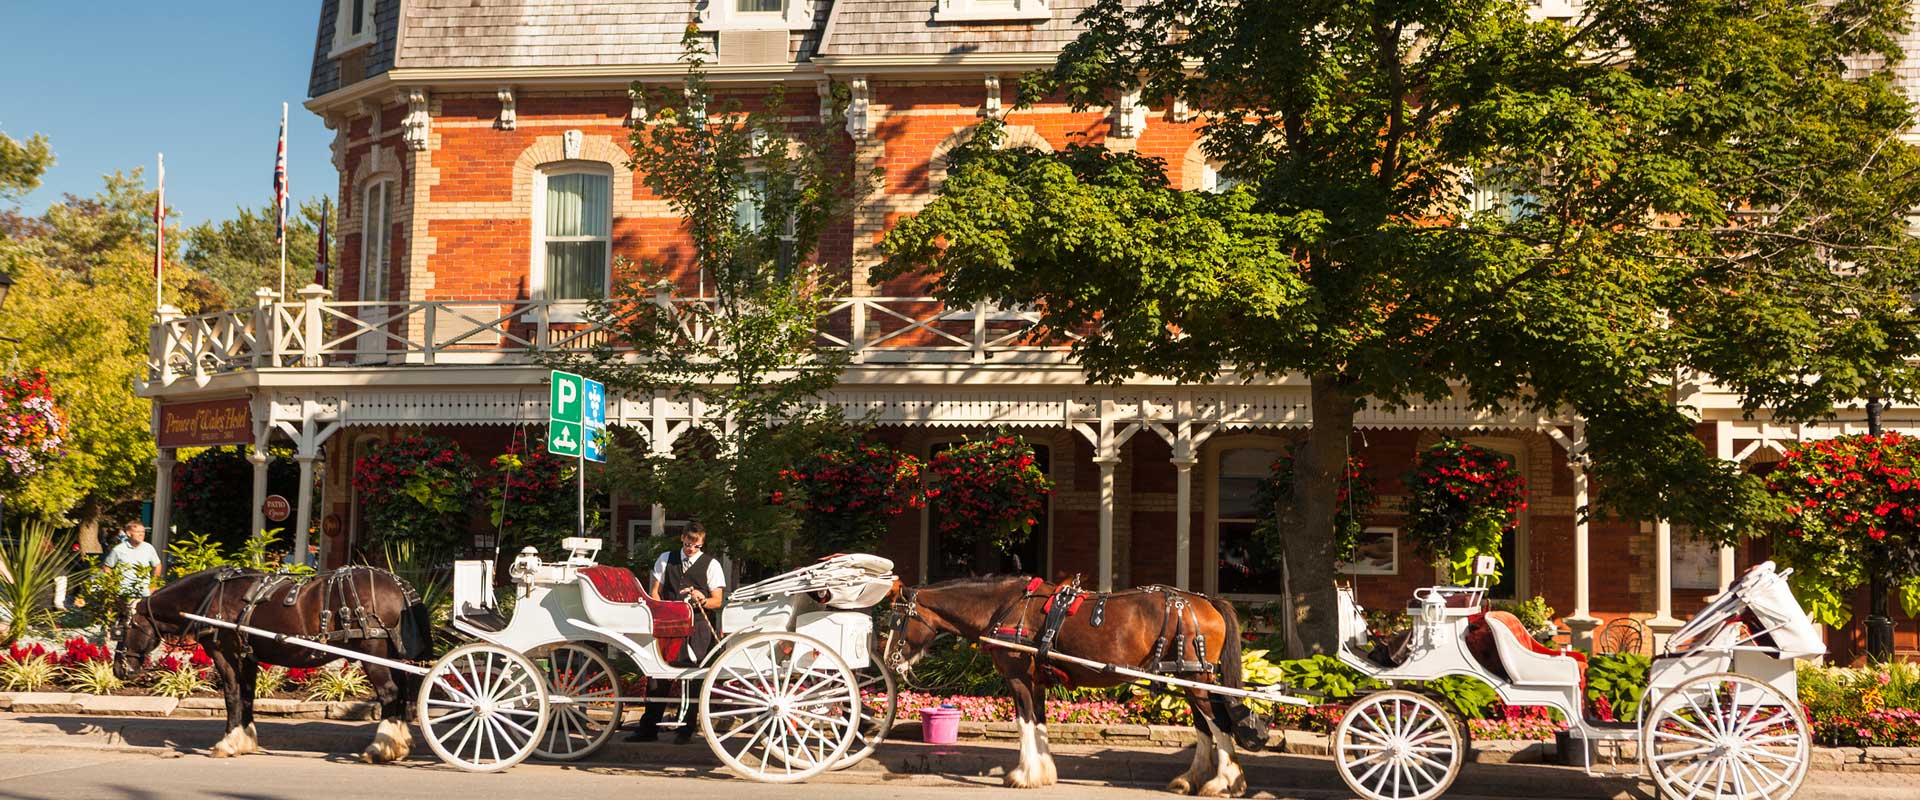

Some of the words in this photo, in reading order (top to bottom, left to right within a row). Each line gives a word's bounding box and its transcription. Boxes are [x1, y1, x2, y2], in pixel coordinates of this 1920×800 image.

[558, 378, 577, 414] P
[165, 412, 190, 433] Prince
[189, 409, 200, 437] of
[199, 407, 225, 433] Wales
[224, 406, 248, 430] Hotel
